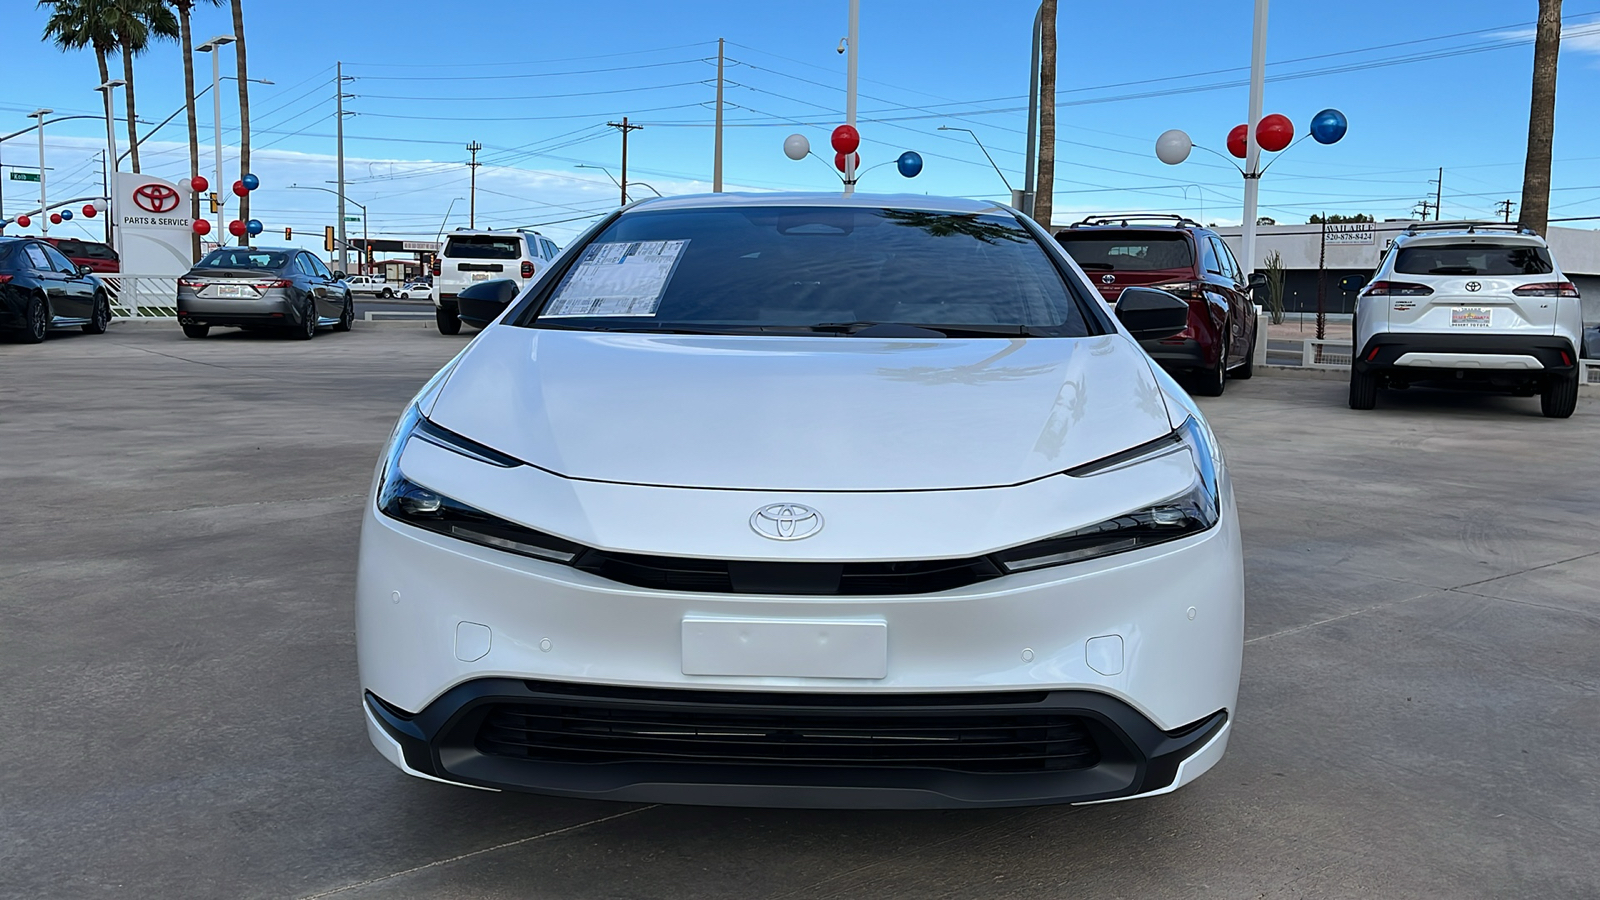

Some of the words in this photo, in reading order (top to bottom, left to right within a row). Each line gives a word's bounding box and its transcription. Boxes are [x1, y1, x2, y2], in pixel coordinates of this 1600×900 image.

[124, 216, 149, 225] PARTS
[150, 217, 157, 225] &
[158, 217, 189, 227] SERVICE
[1326, 224, 1374, 233] AVAILABLE
[1325, 232, 1372, 241] 520-878-8424
